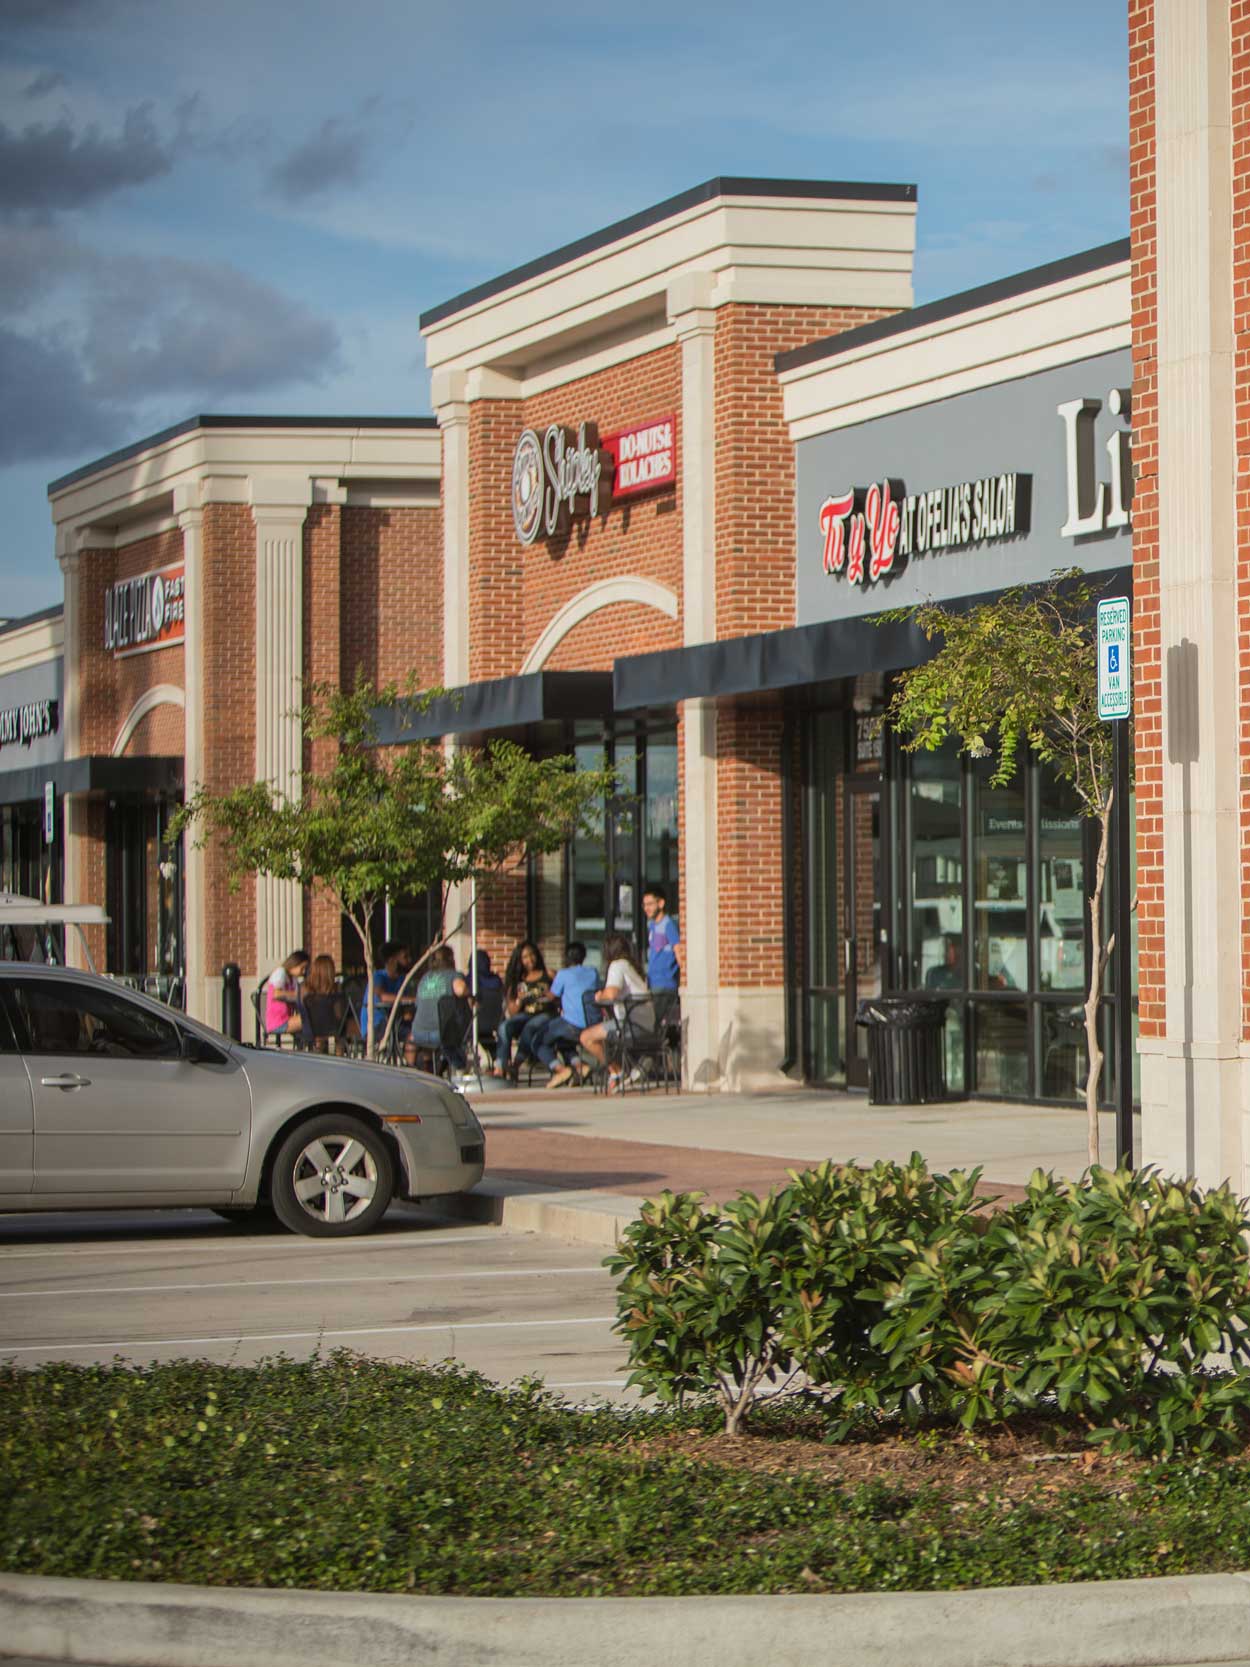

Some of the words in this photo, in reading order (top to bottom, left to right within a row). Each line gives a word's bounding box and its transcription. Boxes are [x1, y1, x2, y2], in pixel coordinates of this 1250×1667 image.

[544, 421, 601, 535] Shipley
[619, 450, 672, 489] KOLACHES
[1057, 389, 1132, 537] Li
[865, 478, 900, 582] Yo
[899, 495, 916, 555] AT
[917, 483, 971, 552] OFELIA'S
[972, 472, 1017, 541] SALON
[1100, 608, 1127, 625] RESERVED
[1102, 627, 1125, 643] PARKING
[1101, 691, 1127, 707] ACCESSIBLE
[1108, 676, 1120, 689] VAN
[20, 699, 50, 747] JOHN'S
